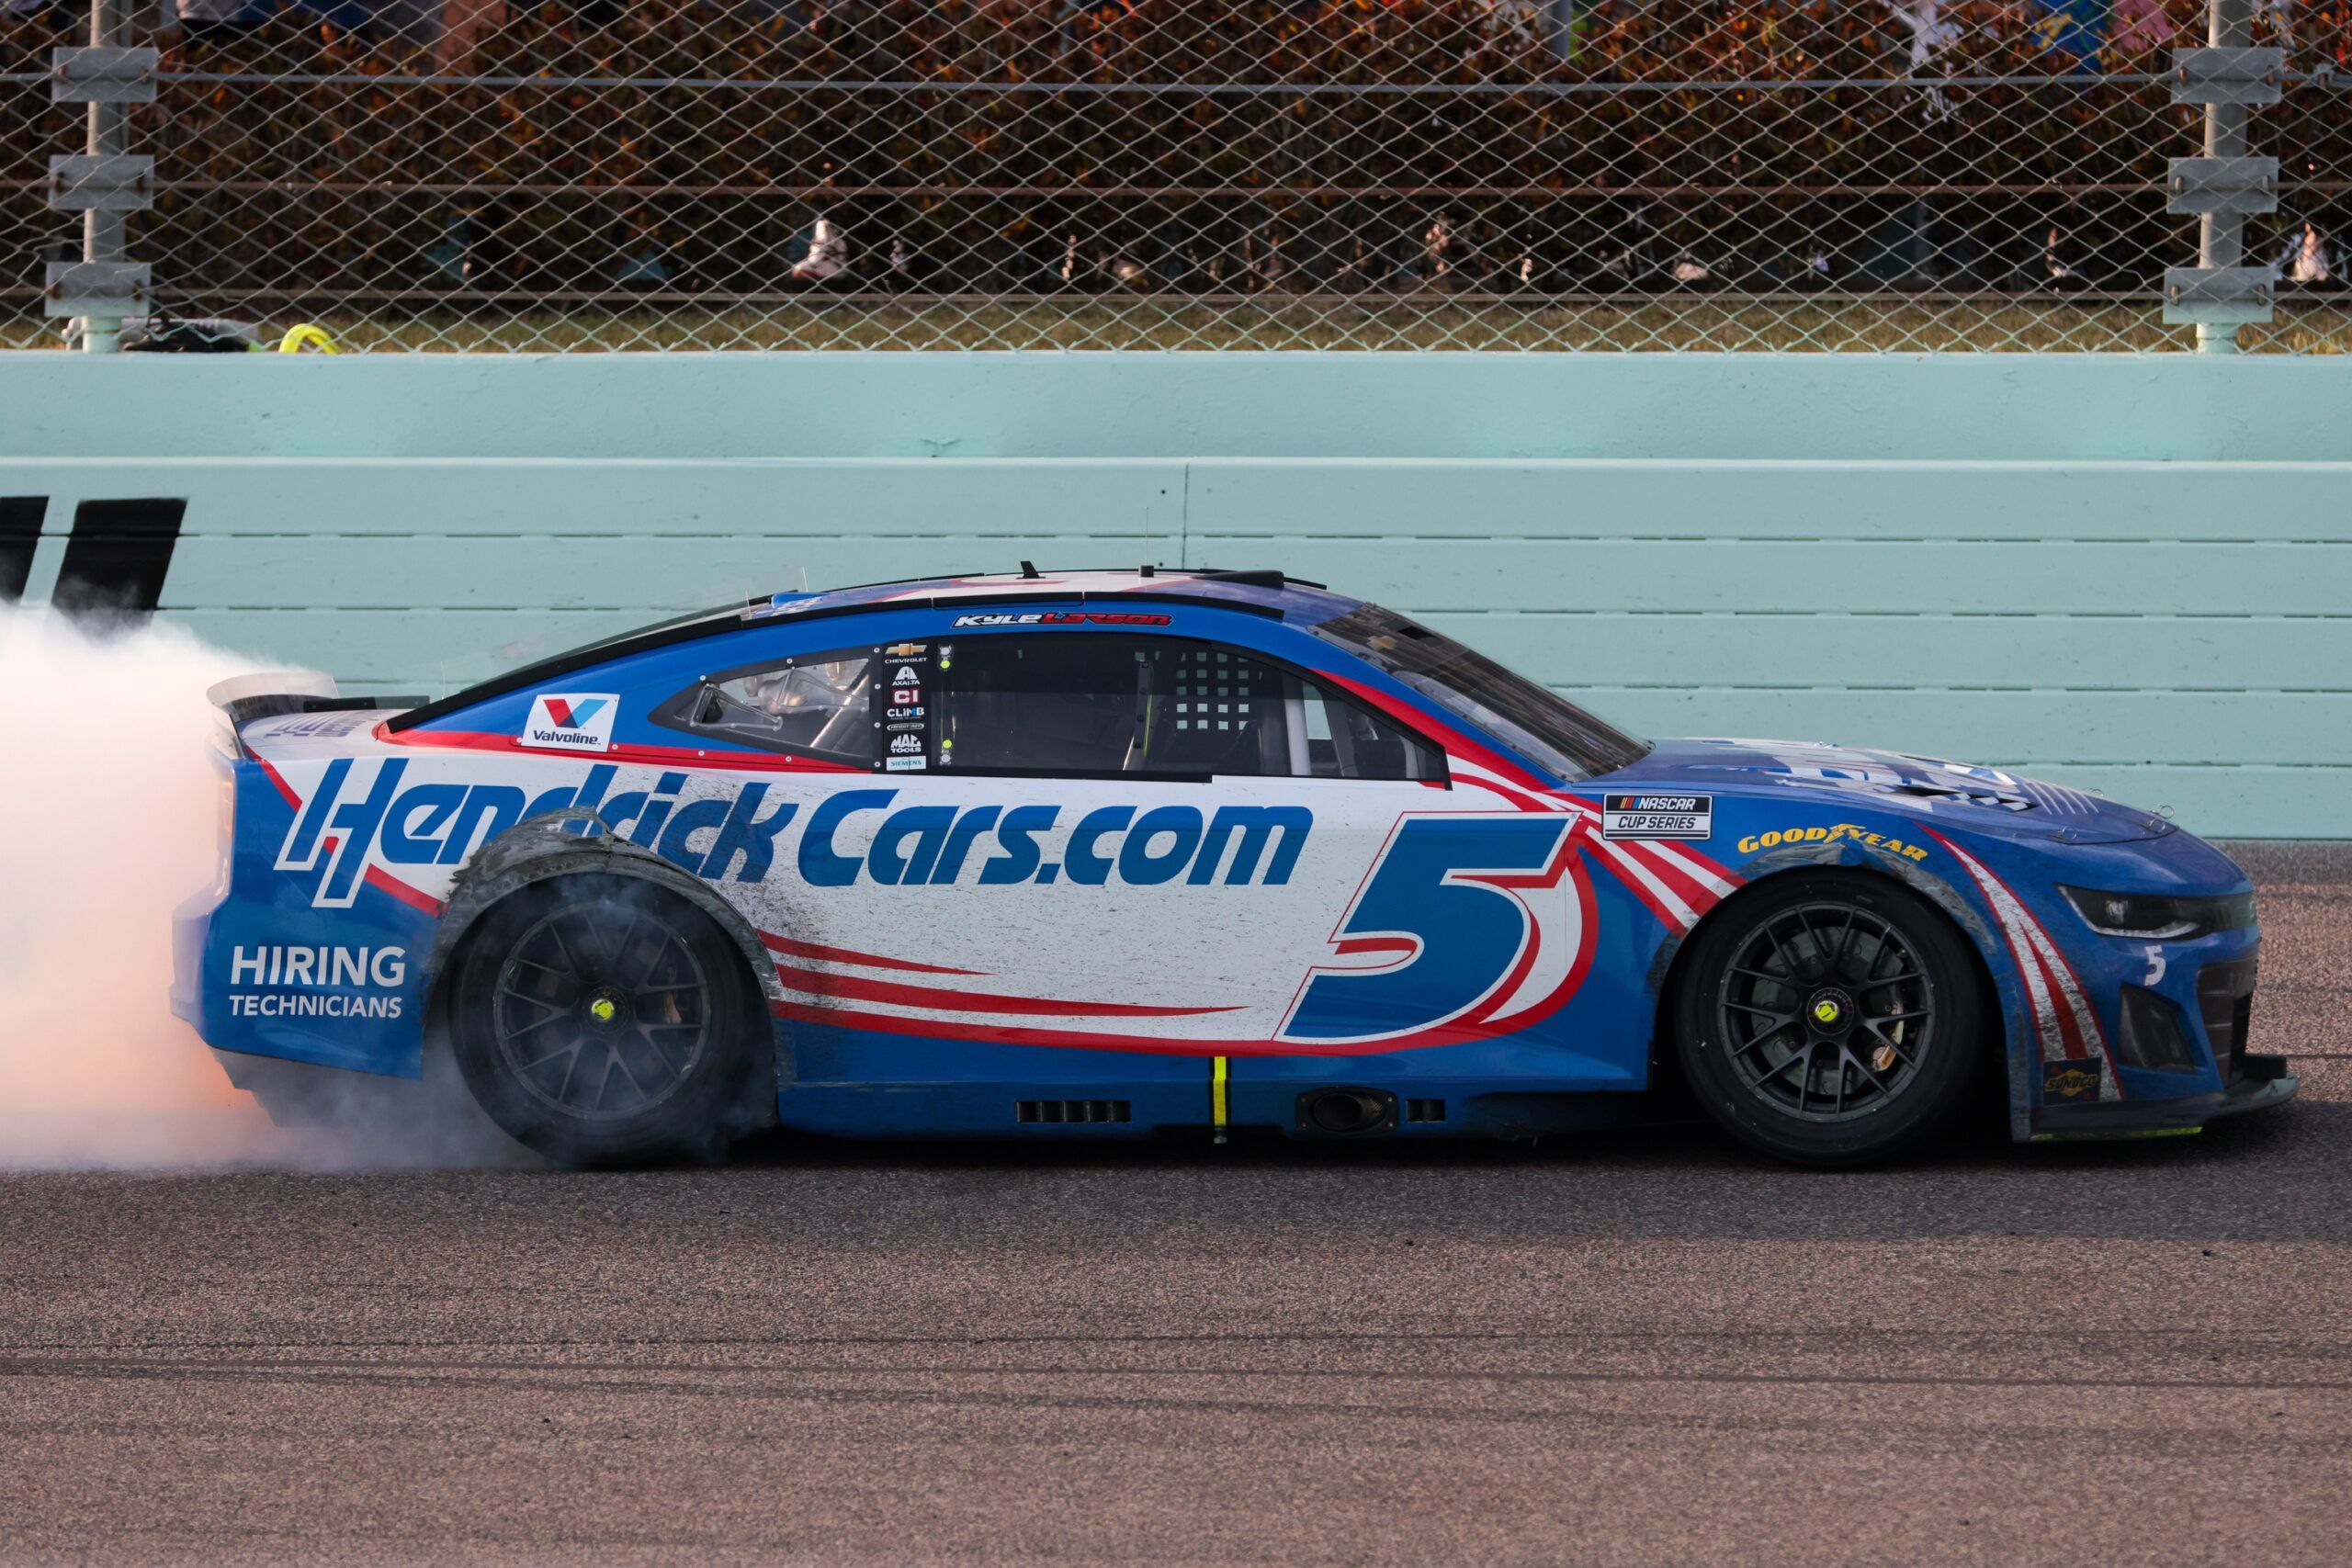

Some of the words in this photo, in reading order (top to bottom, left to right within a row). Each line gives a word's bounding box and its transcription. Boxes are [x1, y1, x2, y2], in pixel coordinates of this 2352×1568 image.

[533, 730, 598, 745] Valvoline
[890, 734, 922, 748] MAC
[1638, 797, 1696, 810] NASCAR
[1618, 816, 1646, 829] CUP
[1647, 817, 1696, 829] SERIES
[1273, 812, 1580, 1044] 5
[230, 945, 406, 987] HIRING
[2143, 944, 2166, 987] 5
[229, 995, 402, 1019] TECHNICIANS
